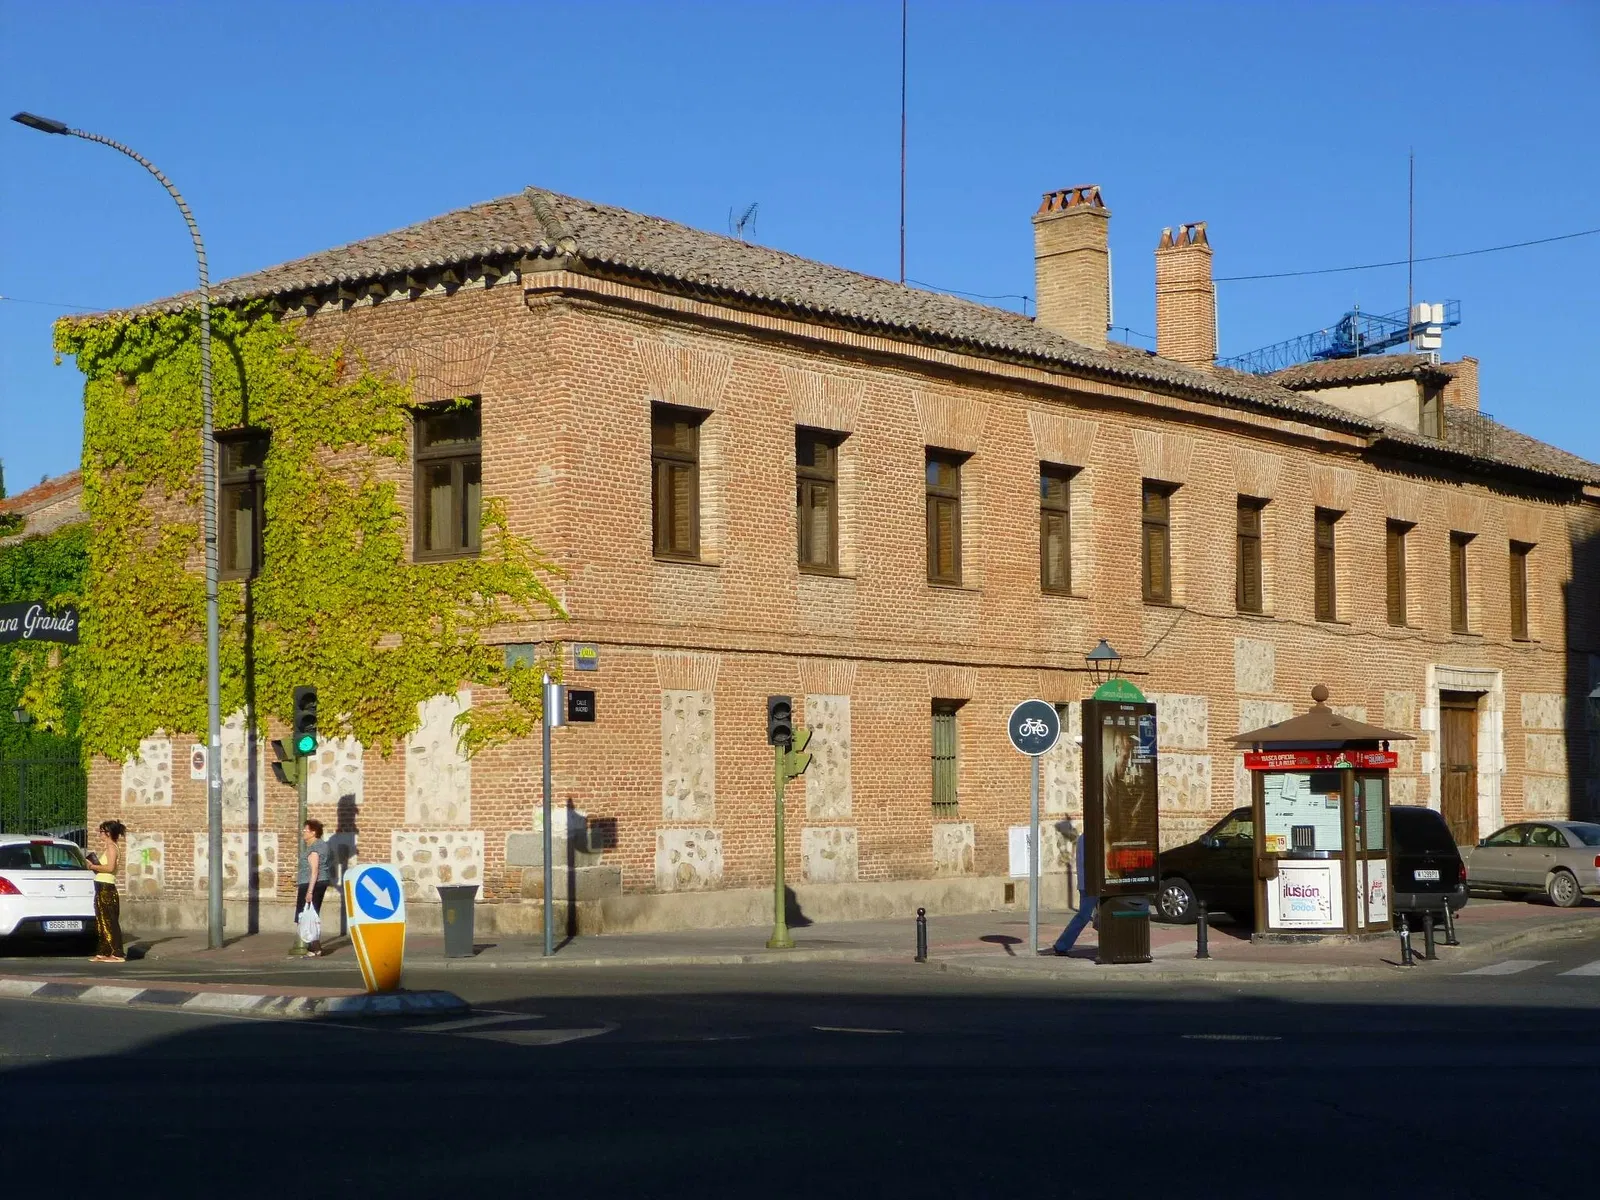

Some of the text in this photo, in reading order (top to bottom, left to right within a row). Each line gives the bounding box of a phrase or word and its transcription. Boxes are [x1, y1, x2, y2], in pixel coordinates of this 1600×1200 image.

[23, 604, 75, 639] Grande
[1277, 837, 1285, 845] 15
[1283, 883, 1320, 898] ilusión
